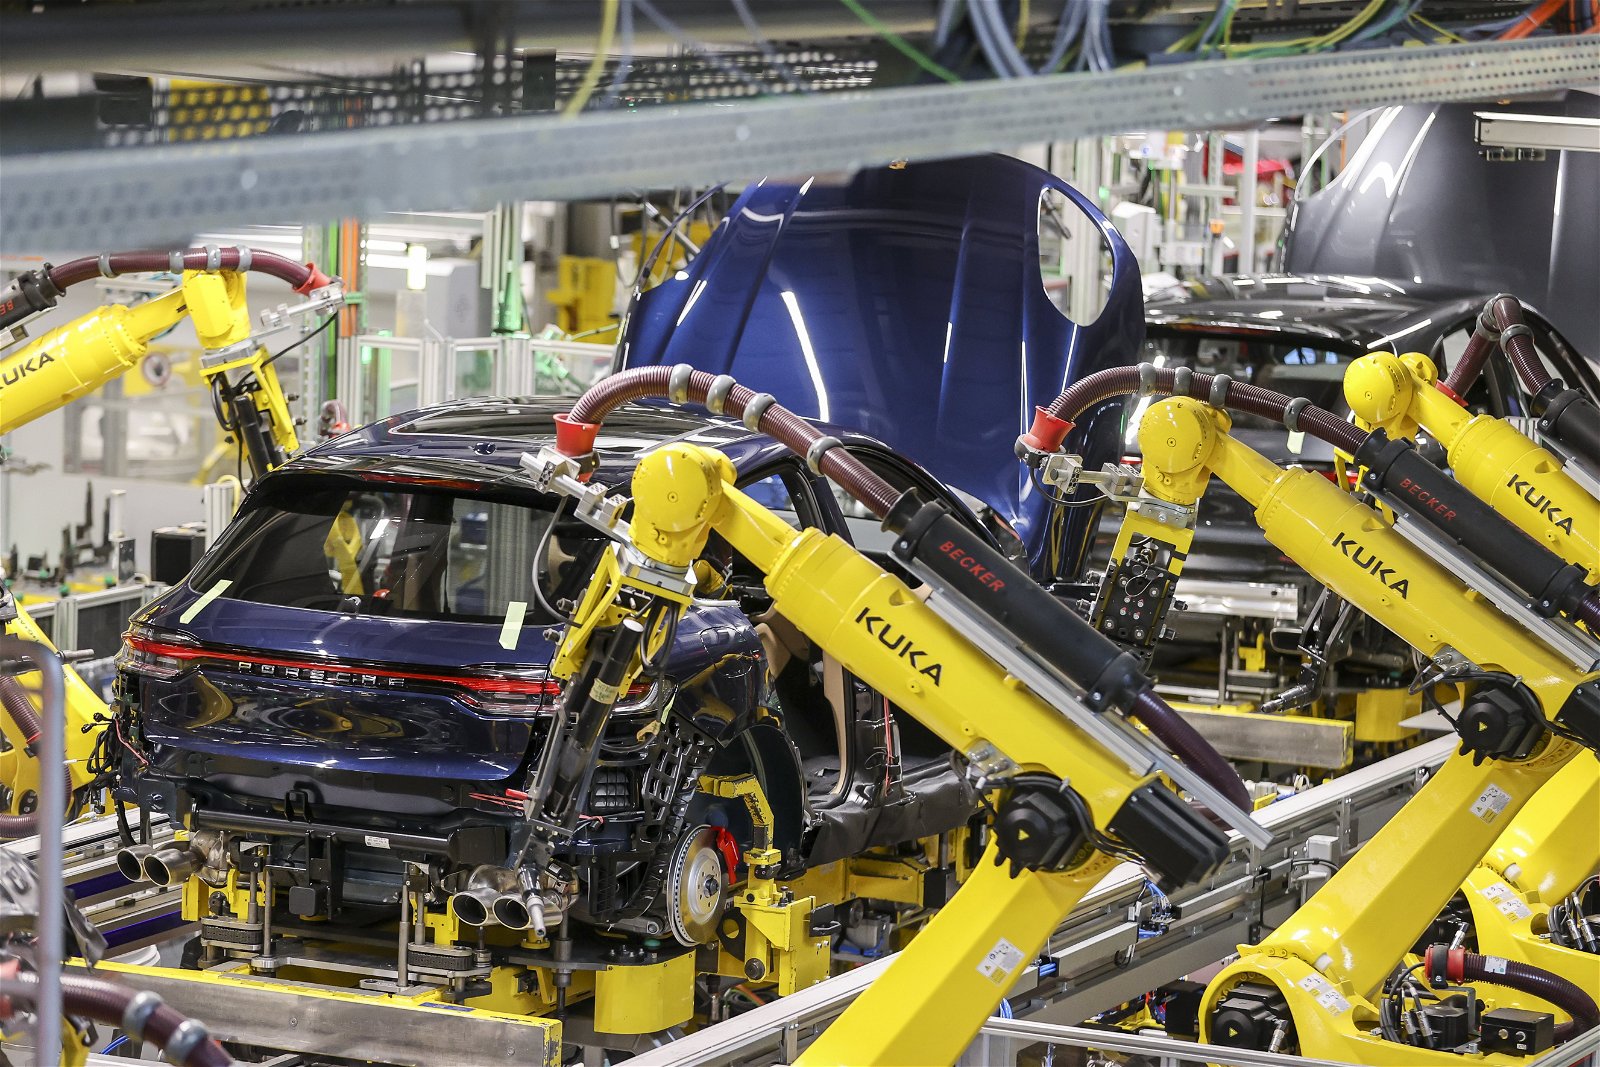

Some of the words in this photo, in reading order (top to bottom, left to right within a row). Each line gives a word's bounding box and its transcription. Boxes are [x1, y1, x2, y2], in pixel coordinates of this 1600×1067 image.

[0, 351, 55, 390] UKA
[1400, 478, 1457, 521] BECKER
[1506, 473, 1573, 536] KUKA
[939, 541, 1006, 592] BECKER
[1331, 532, 1409, 600] KUKA
[855, 606, 942, 687] KUKA
[238, 661, 405, 687] PORSCHE
